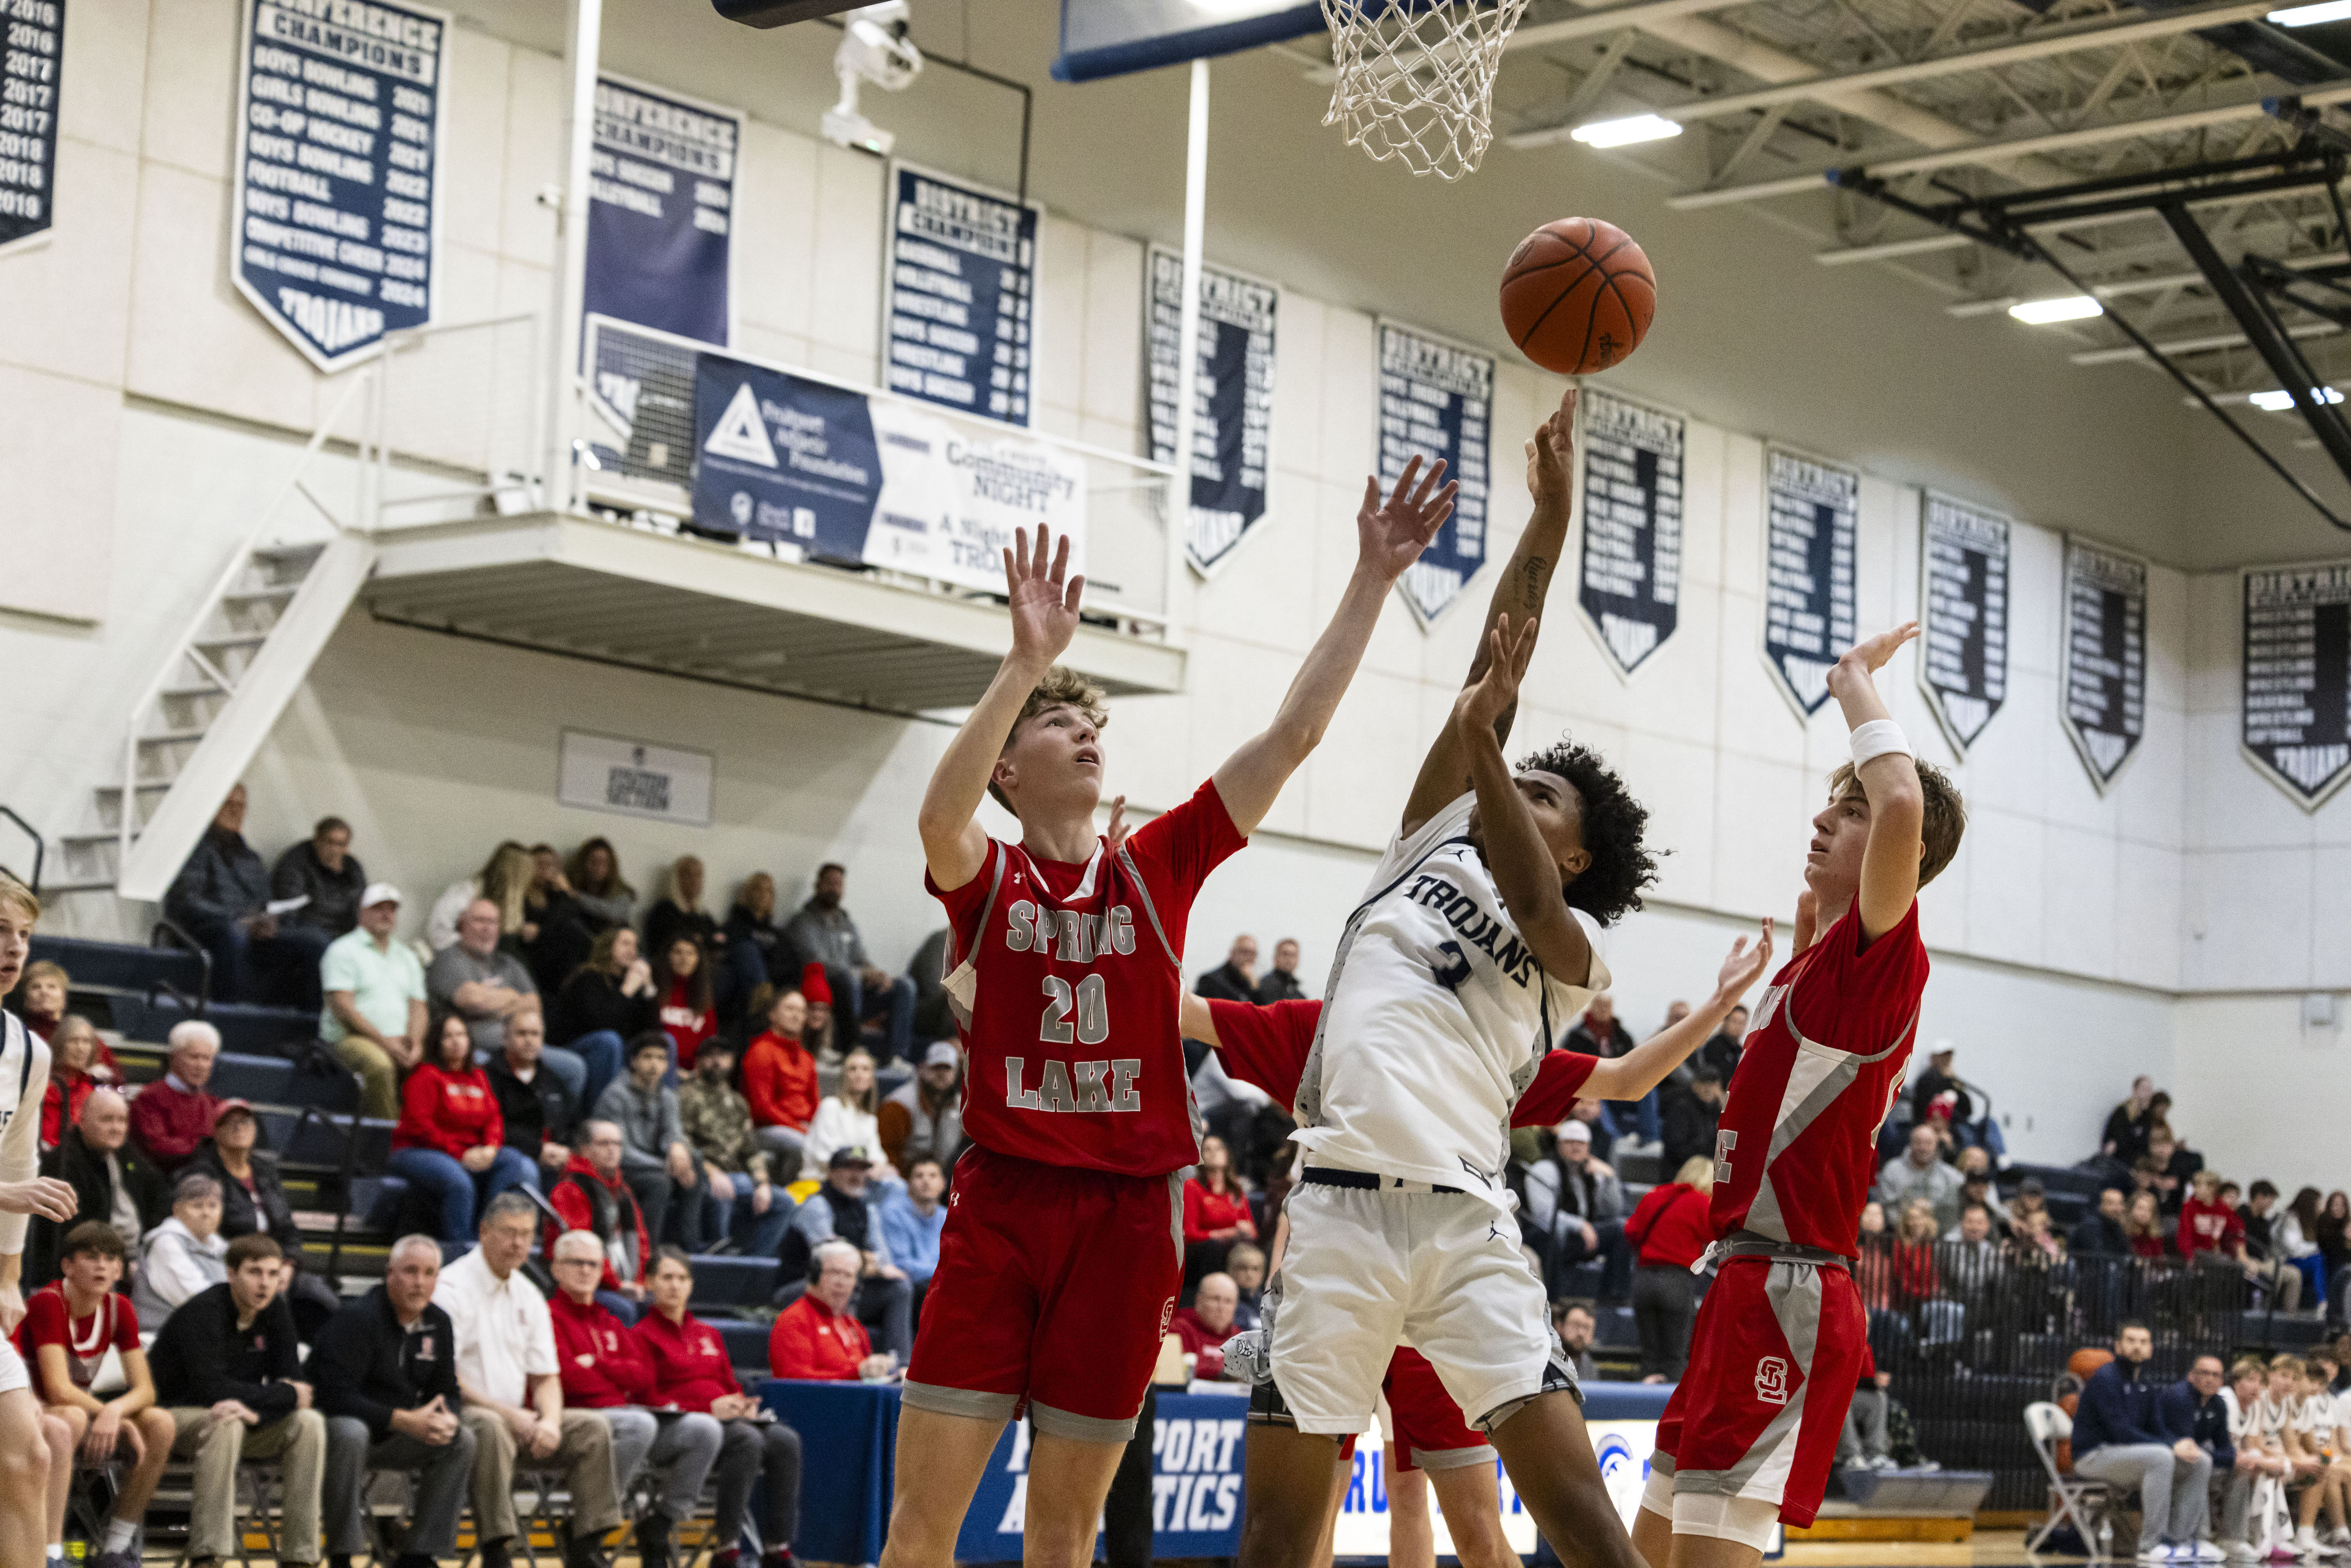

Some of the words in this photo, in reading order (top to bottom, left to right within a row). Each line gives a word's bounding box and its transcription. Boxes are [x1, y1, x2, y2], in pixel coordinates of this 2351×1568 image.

[262, 0, 440, 52] NFERENCE
[274, 12, 421, 74] CHAMPIONS
[3, 76, 52, 107] 2017
[5, 49, 53, 82] 2017
[254, 45, 300, 77] BOYS
[303, 58, 378, 101] BOWLING
[1, 103, 49, 133] 2017
[305, 88, 381, 130] BOWLING
[596, 86, 733, 148] ONFERENCE
[247, 159, 331, 202] FOOTBALL
[249, 130, 295, 163] BOYS
[297, 143, 373, 184] BOWLING
[0, 189, 40, 219] 019
[912, 212, 1016, 256] CHAMPION
[278, 286, 384, 351] TROJANS
[1006, 900, 1136, 963] SPRING
[1403, 875, 1540, 988] TROJANS
[1040, 974, 1109, 1044] 20
[1006, 1057, 1141, 1112] LAKE
